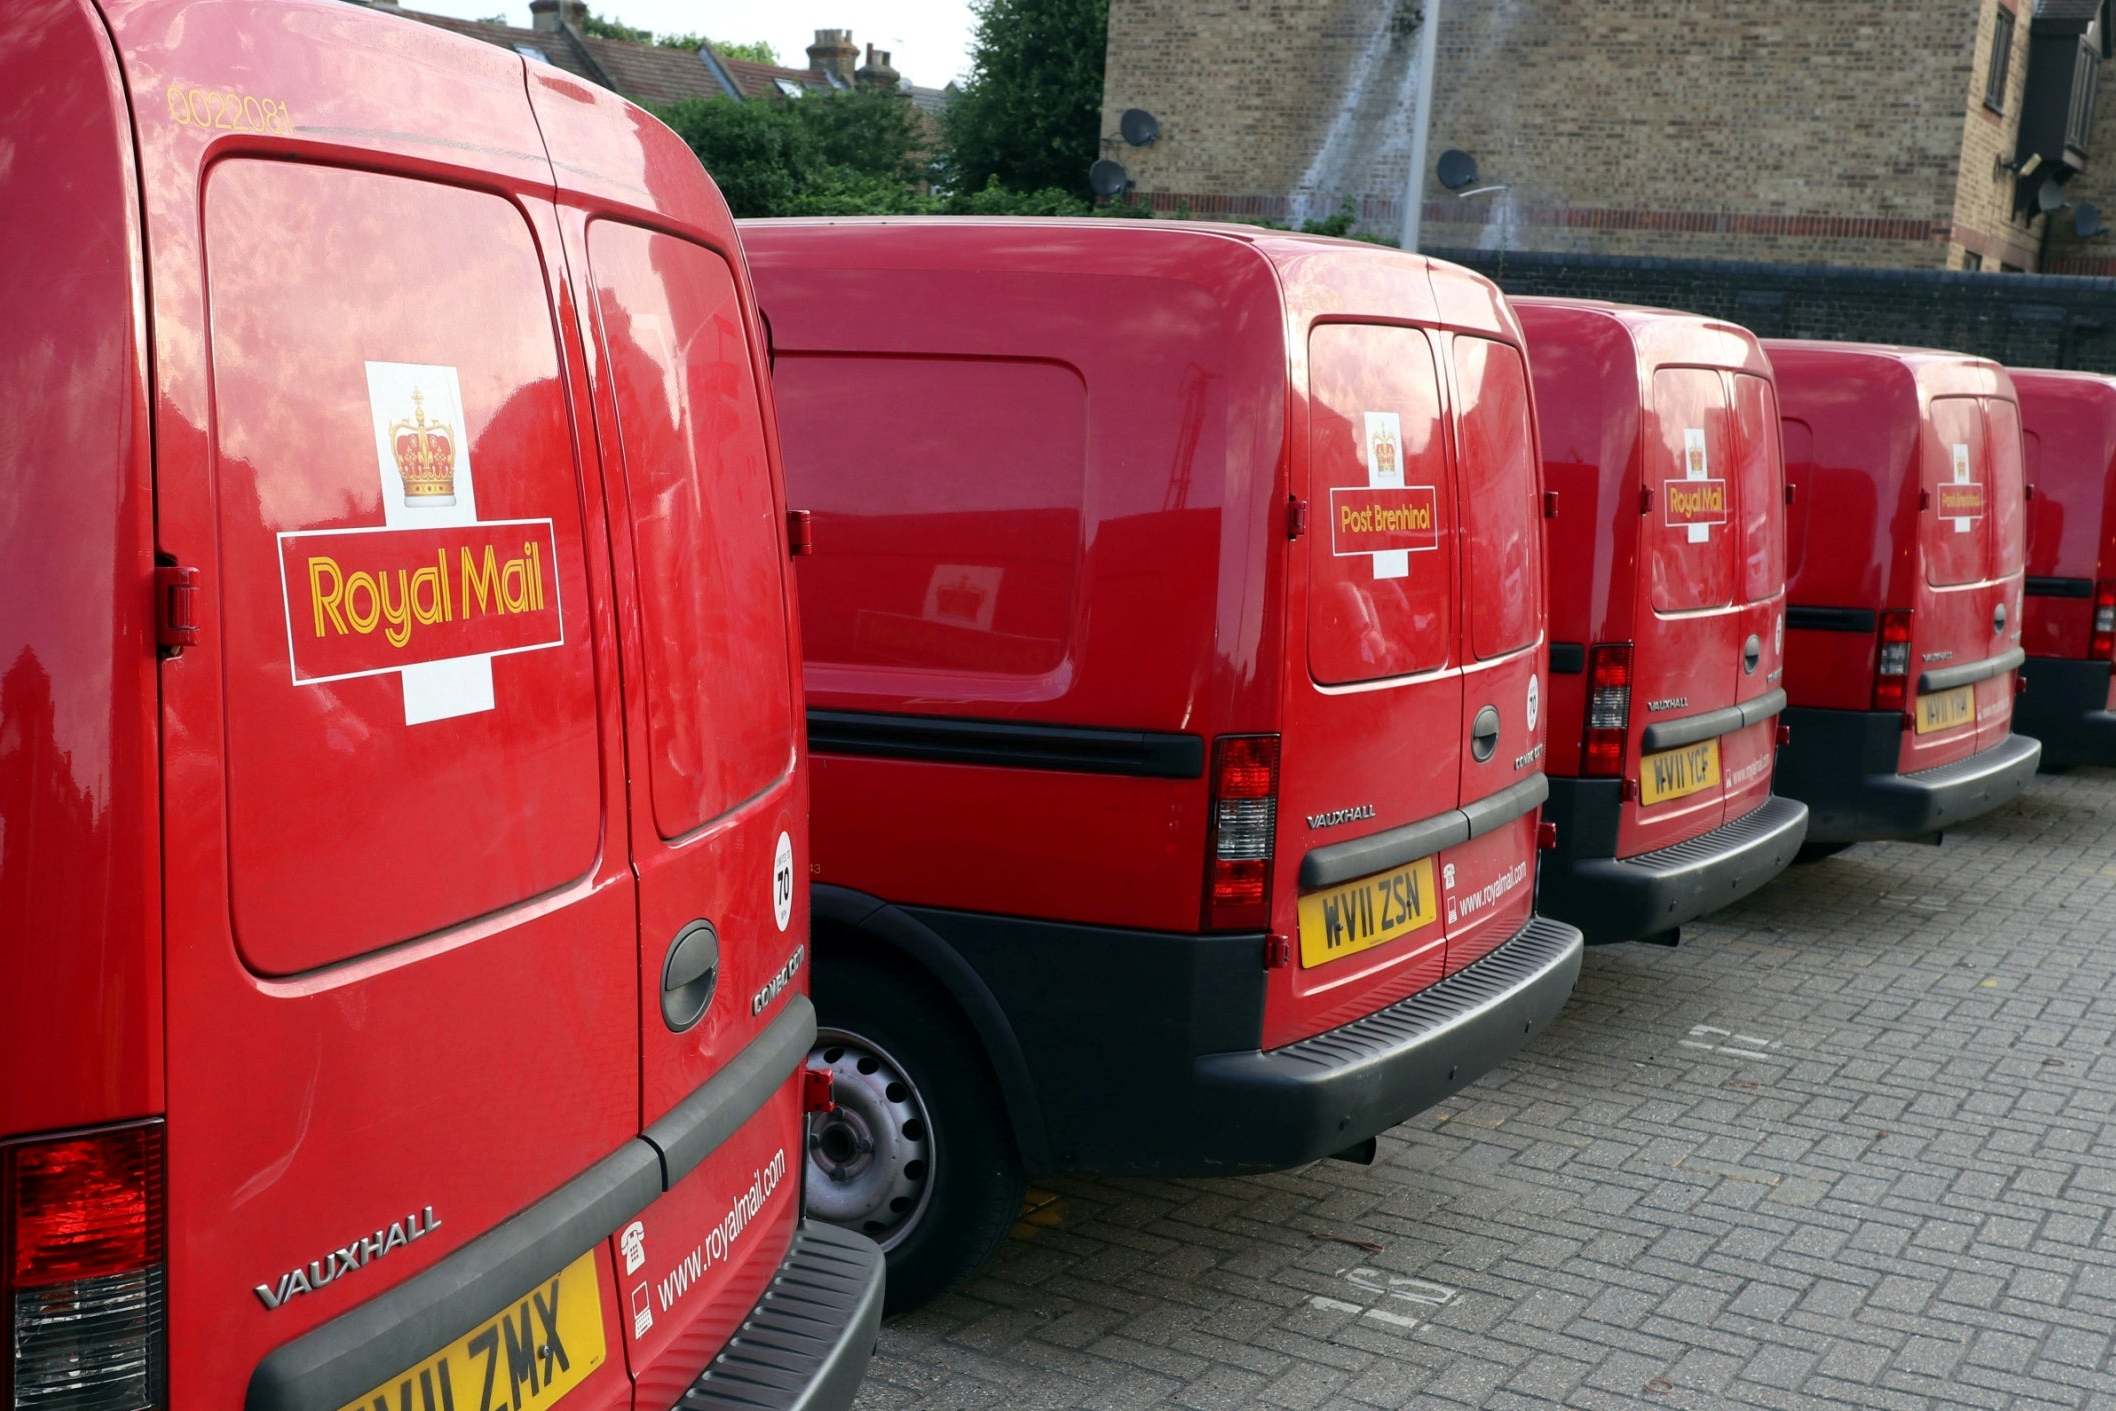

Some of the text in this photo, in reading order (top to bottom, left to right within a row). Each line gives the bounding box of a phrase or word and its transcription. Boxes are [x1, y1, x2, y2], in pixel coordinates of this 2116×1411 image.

[166, 86, 295, 134] 0022081
[1341, 503, 1430, 533] Post Brenhinol
[1670, 487, 1723, 518] Royal Mail
[308, 541, 545, 648] Royal Mail
[1648, 697, 1688, 712] VAUXHALL
[1306, 804, 1376, 830] VAUXHALL
[777, 866, 790, 906] 70
[1322, 869, 1422, 949] WV11 ZSN
[1459, 861, 1526, 918] www.royalmail.com
[657, 1147, 786, 1312] www.royalmail.com
[254, 1205, 443, 1311] VAUXHALL
[467, 1278, 570, 1411] ZMX
